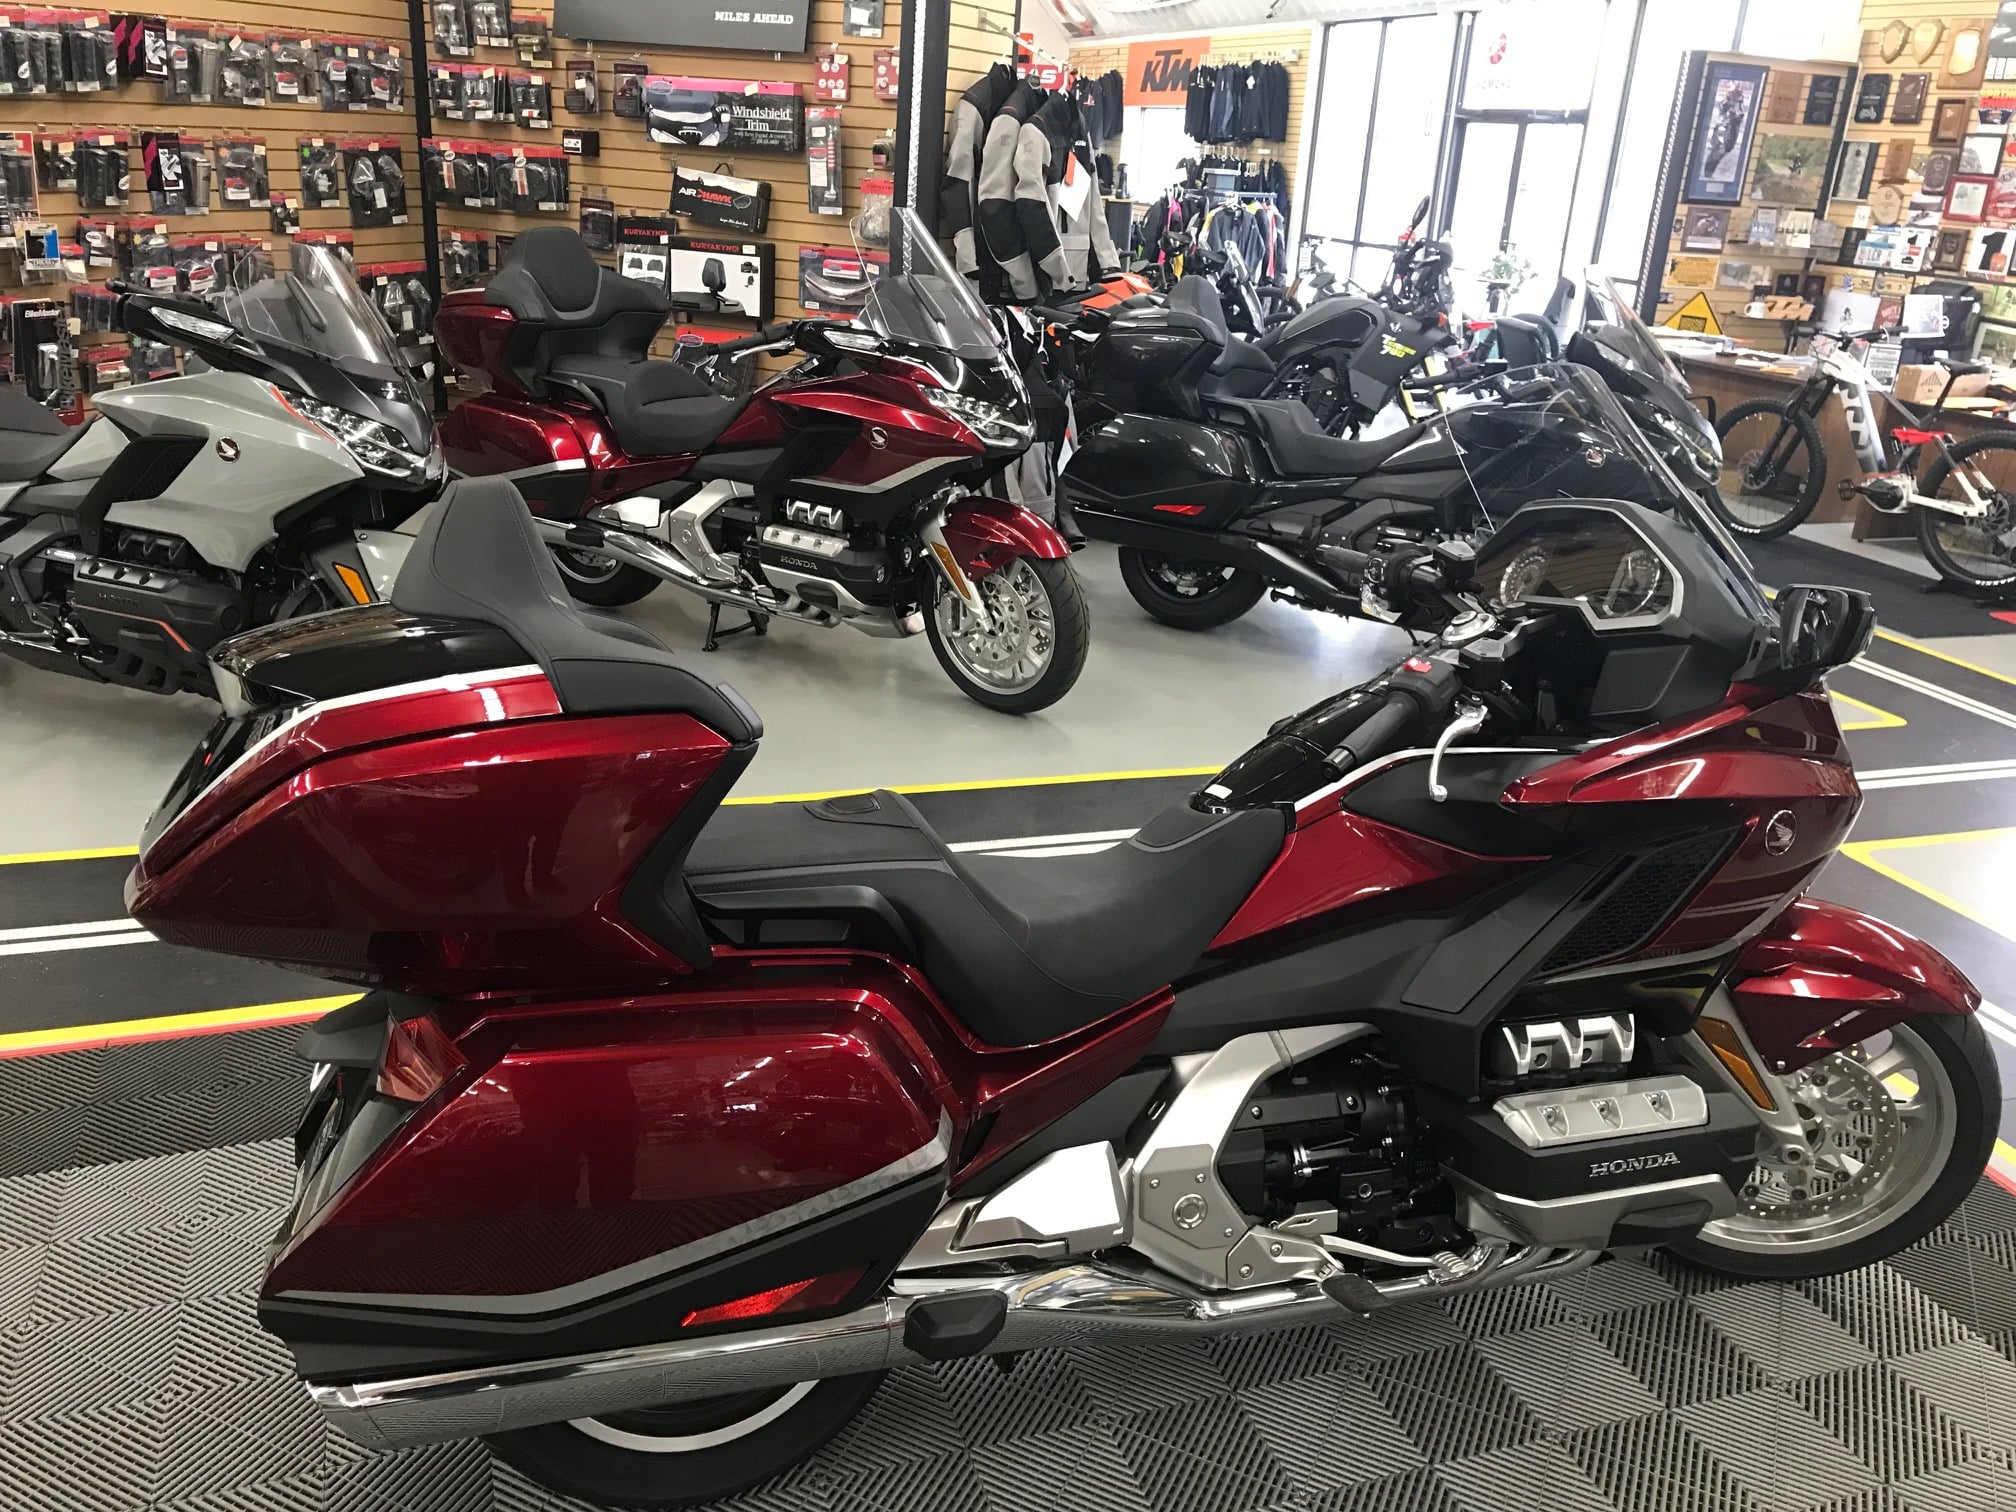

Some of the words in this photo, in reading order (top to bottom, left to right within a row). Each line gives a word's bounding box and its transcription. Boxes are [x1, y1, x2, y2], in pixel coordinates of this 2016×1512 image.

[714, 11, 750, 22] MILES
[752, 13, 794, 25] AHEAD
[1140, 49, 1192, 92] KTM
[732, 105, 790, 119] Windshield
[745, 119, 770, 131] Trim
[781, 555, 818, 570] HONDA
[1589, 1152, 1681, 1178] HONDA
